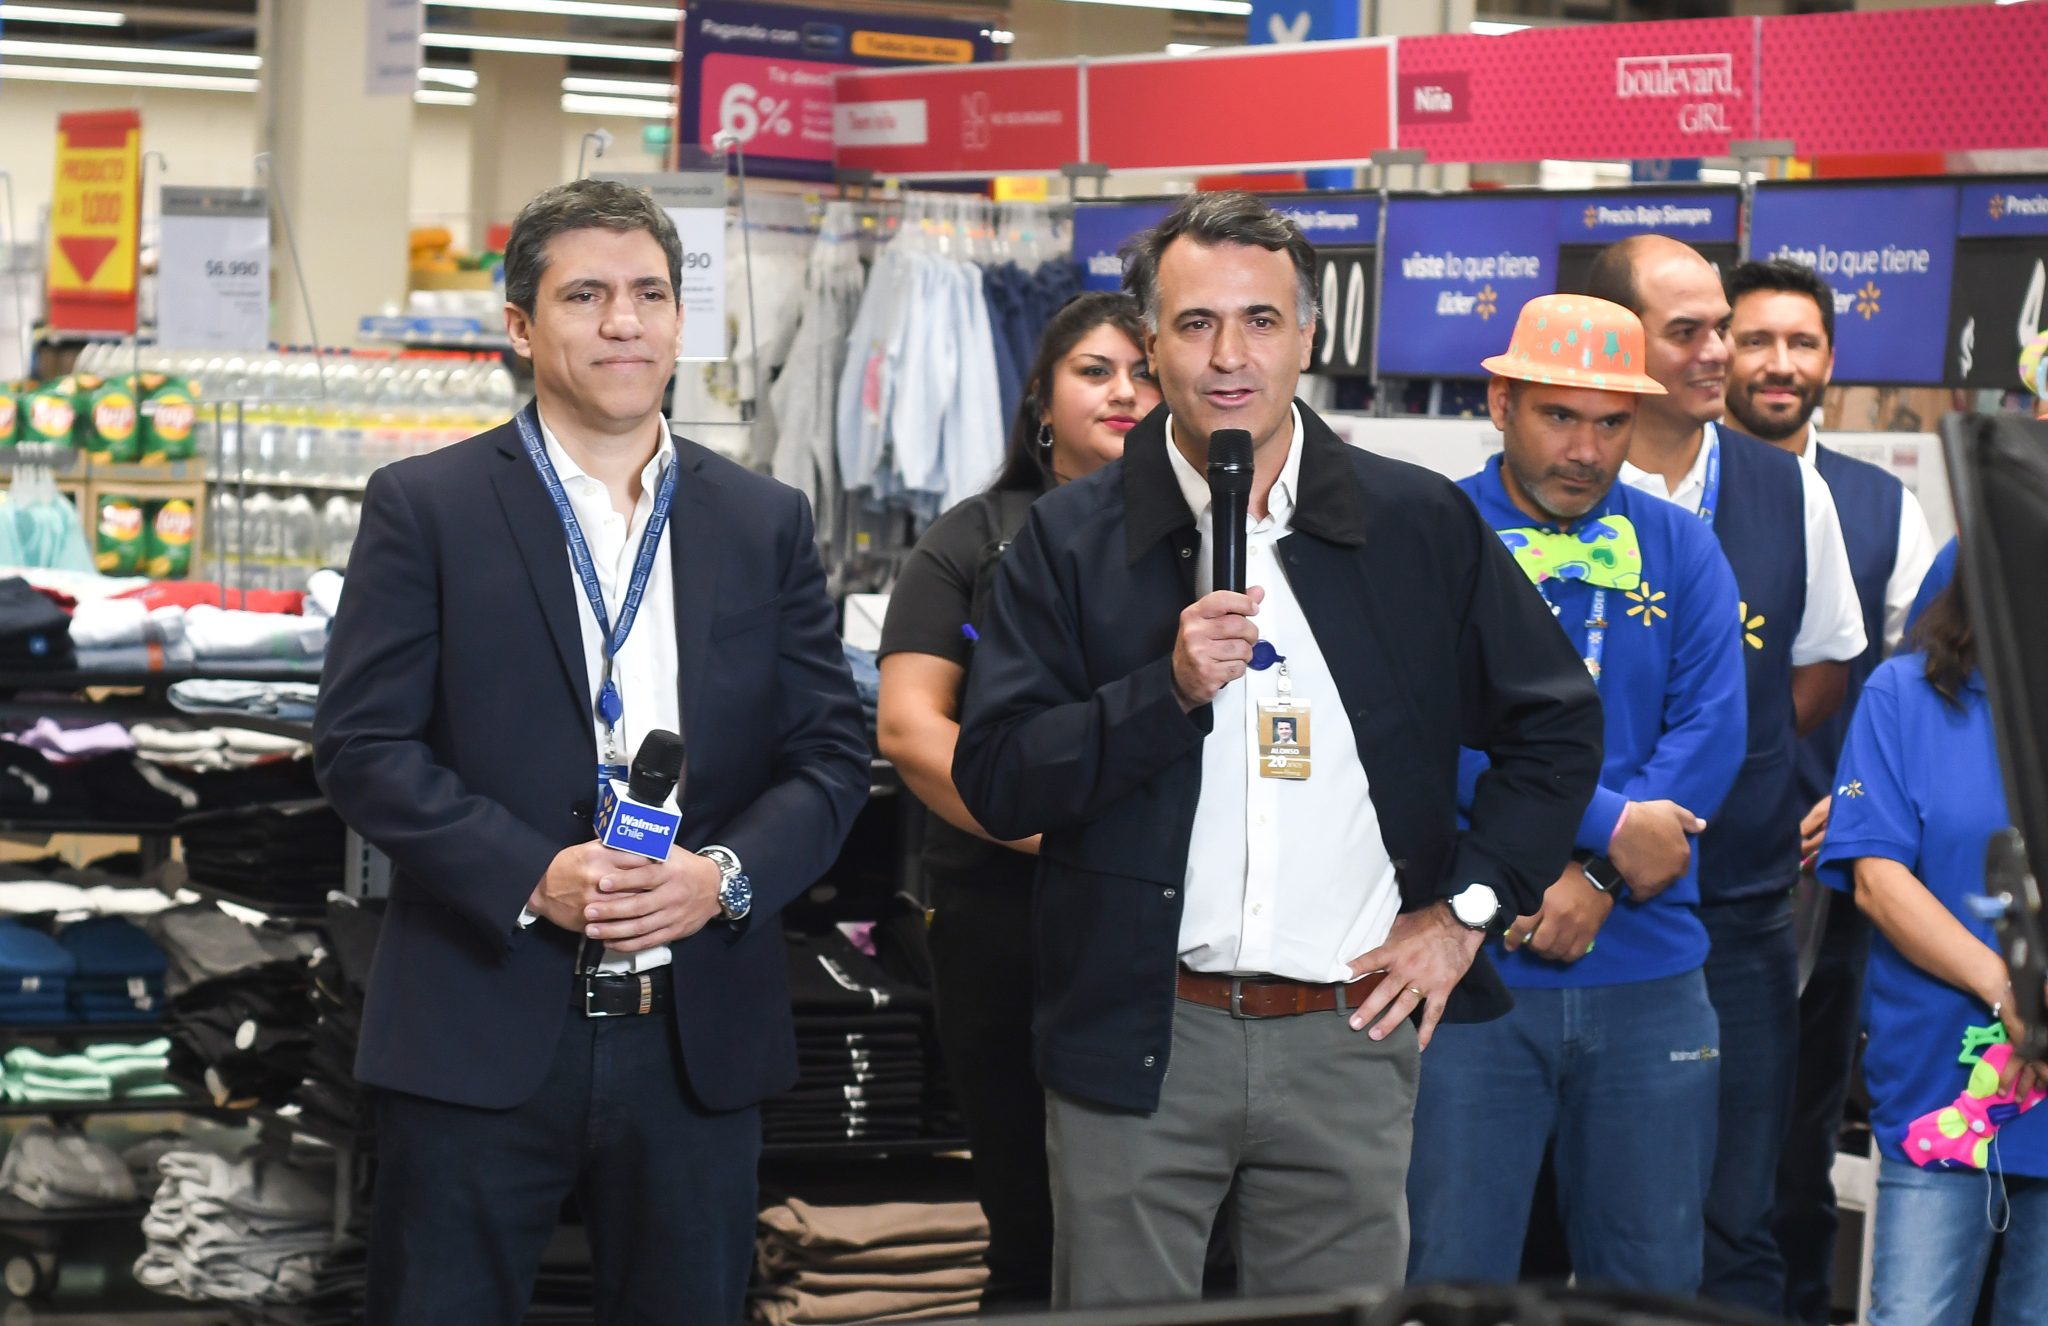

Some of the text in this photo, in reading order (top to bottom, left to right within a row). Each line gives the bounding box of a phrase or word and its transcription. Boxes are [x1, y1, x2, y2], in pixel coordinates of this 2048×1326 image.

[1412, 85, 1454, 113] Niña
[720, 82, 793, 147] 6%
[1678, 101, 1733, 134] GIRL
[1598, 204, 1712, 228] Precio Bajo Siempre
[682, 252, 712, 269] 90
[1402, 250, 1540, 282] viste lo que tiene
[1818, 244, 1838, 275] lo
[1840, 249, 1879, 279] que
[1881, 244, 1930, 273] tiene
[1266, 755, 1287, 768] 20
[616, 824, 644, 840] Chile
[620, 813, 670, 835] Walmart
